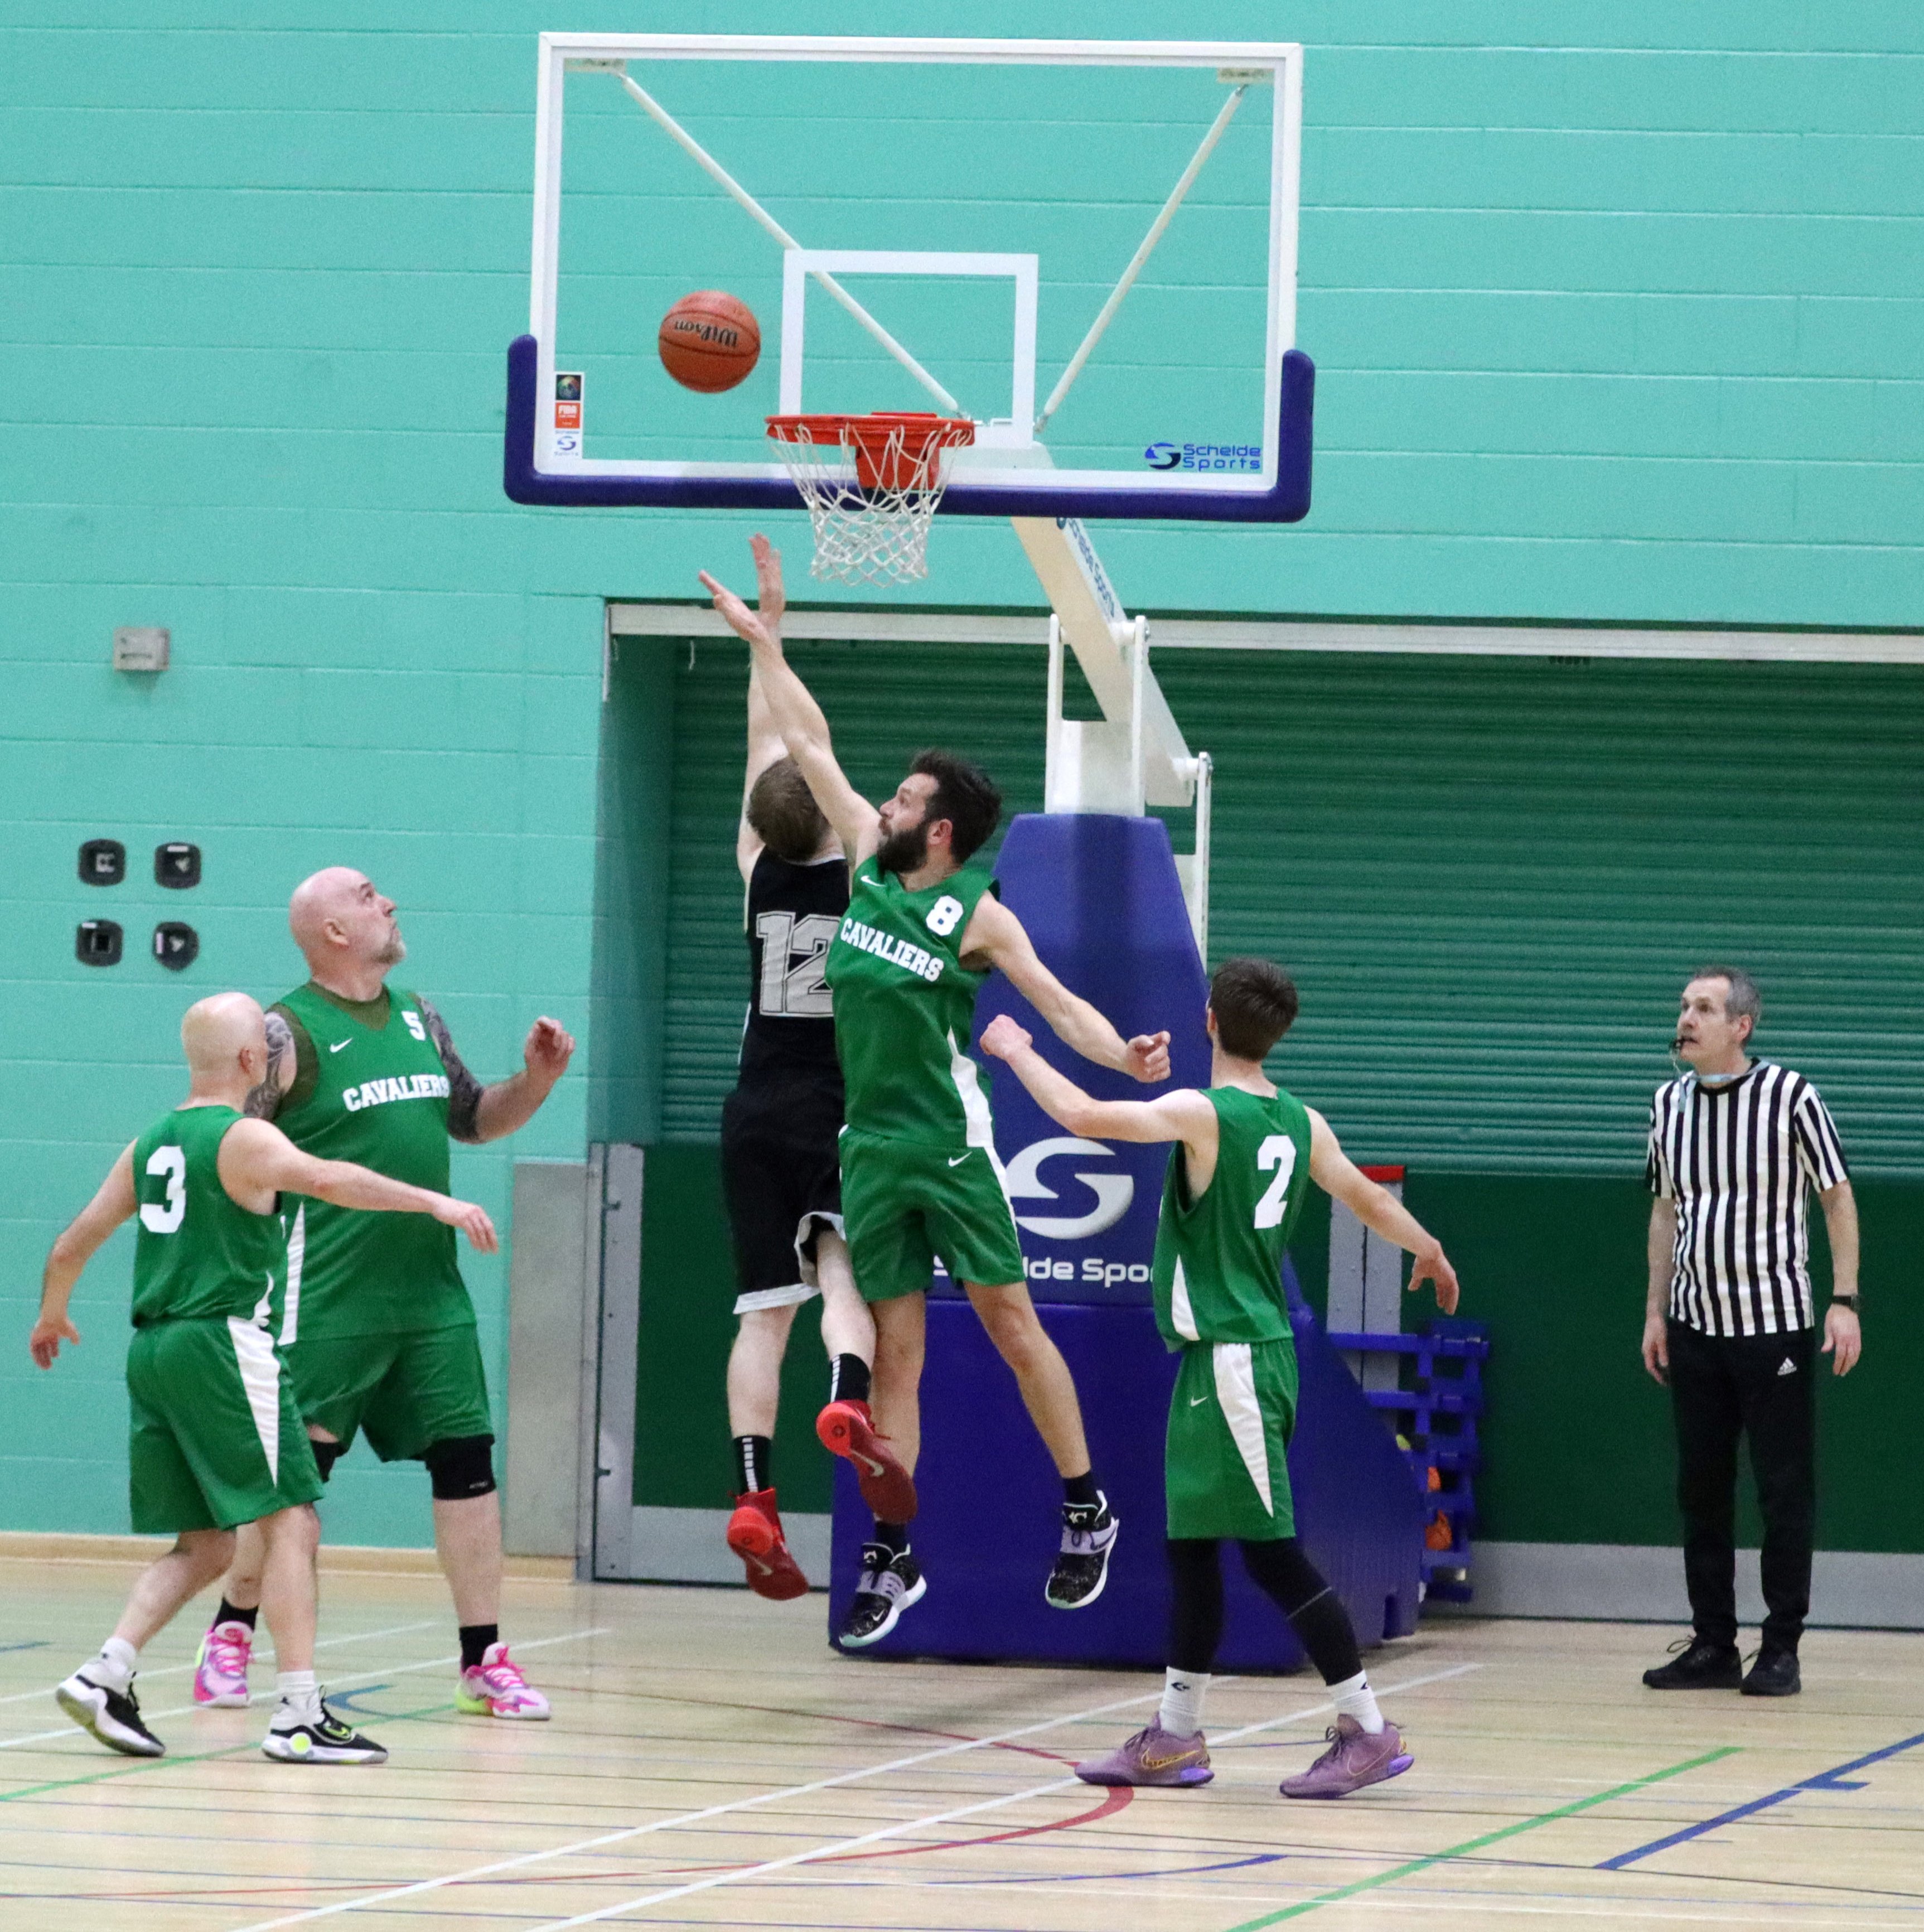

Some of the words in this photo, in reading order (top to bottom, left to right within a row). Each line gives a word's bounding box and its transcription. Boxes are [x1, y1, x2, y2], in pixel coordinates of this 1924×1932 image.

[674, 319, 738, 348] Wilson
[1183, 443, 1261, 457] Schelde
[1183, 456, 1260, 471] Sports
[925, 895, 964, 936] 8
[756, 910, 841, 1017] 12
[840, 918, 944, 982] CAVALIERS
[401, 1011, 426, 1041] 5
[342, 1074, 450, 1112] CAVALIERS
[139, 1146, 186, 1234] 3
[1254, 1136, 1297, 1229] 2
[1082, 1258, 1153, 1288] Spo
